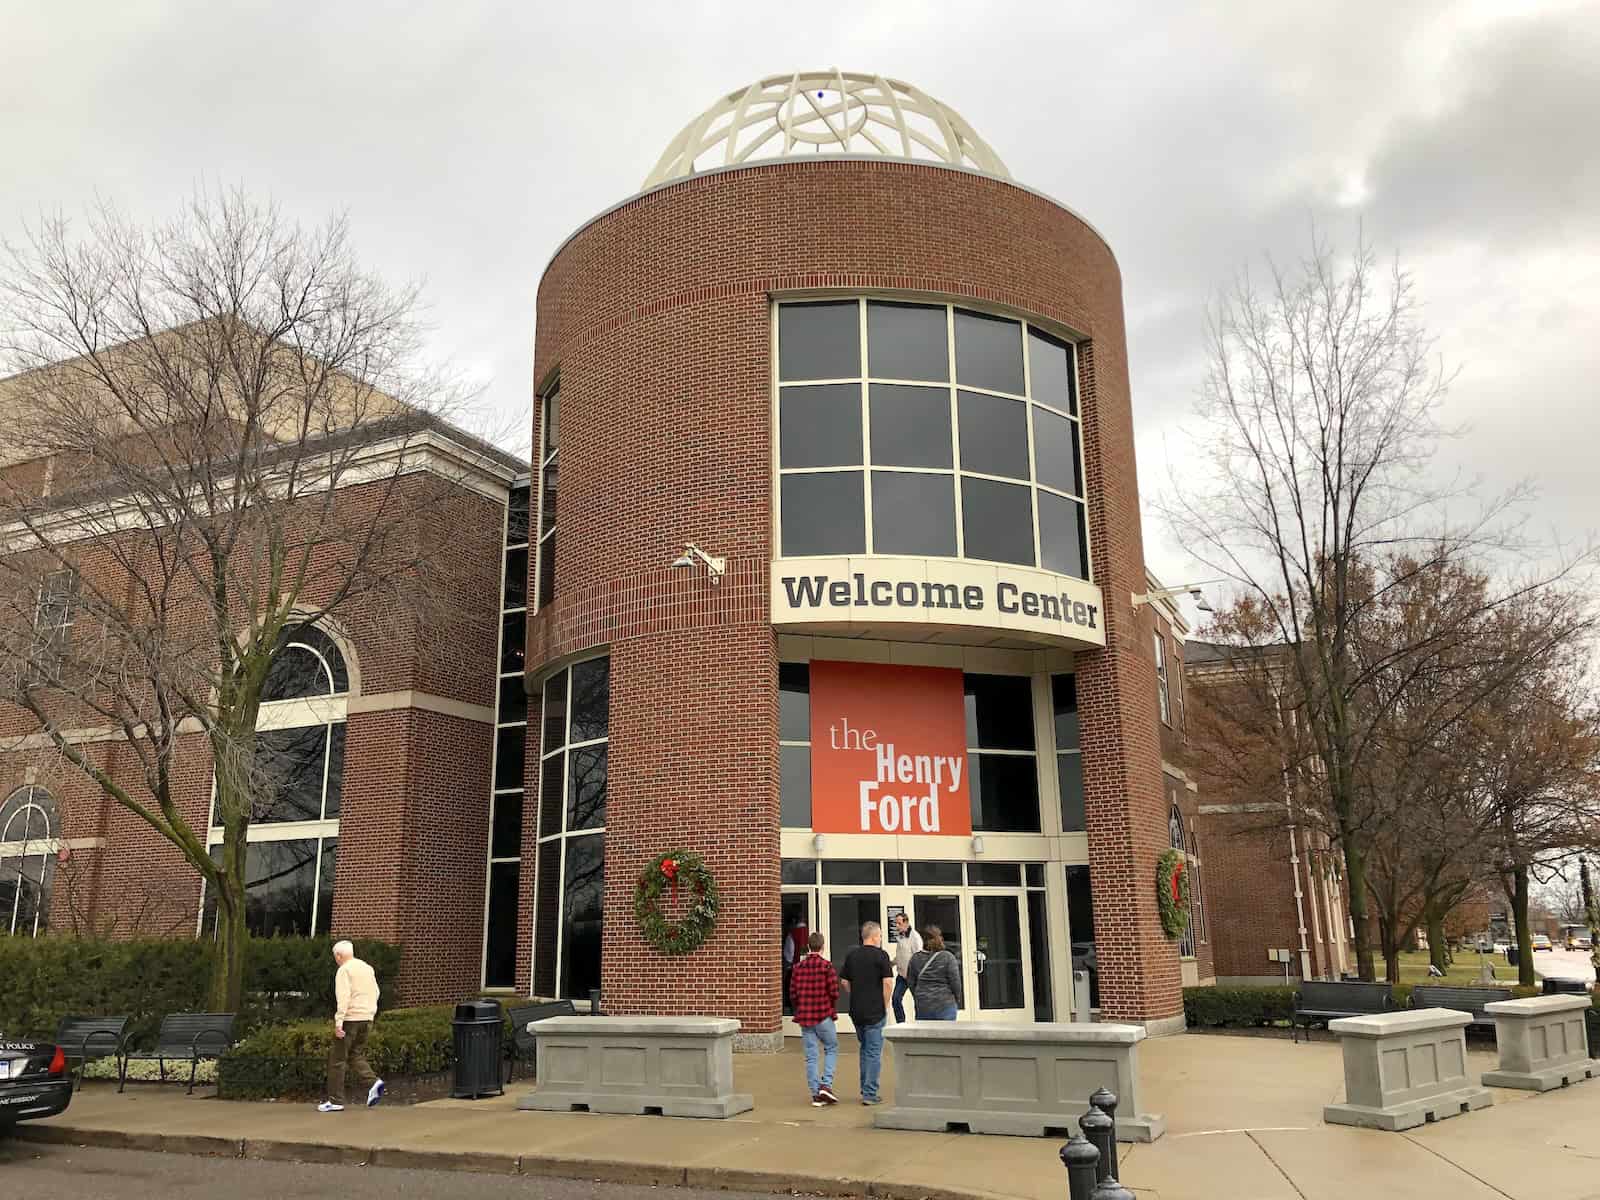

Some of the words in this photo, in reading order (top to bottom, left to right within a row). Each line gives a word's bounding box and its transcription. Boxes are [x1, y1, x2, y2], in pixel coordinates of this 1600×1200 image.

[781, 573, 984, 610] Welcome
[997, 582, 1097, 629] Center
[830, 717, 878, 751] the
[876, 743, 962, 793] Henry
[859, 780, 940, 832] Ford
[6, 1042, 36, 1050] POLICE
